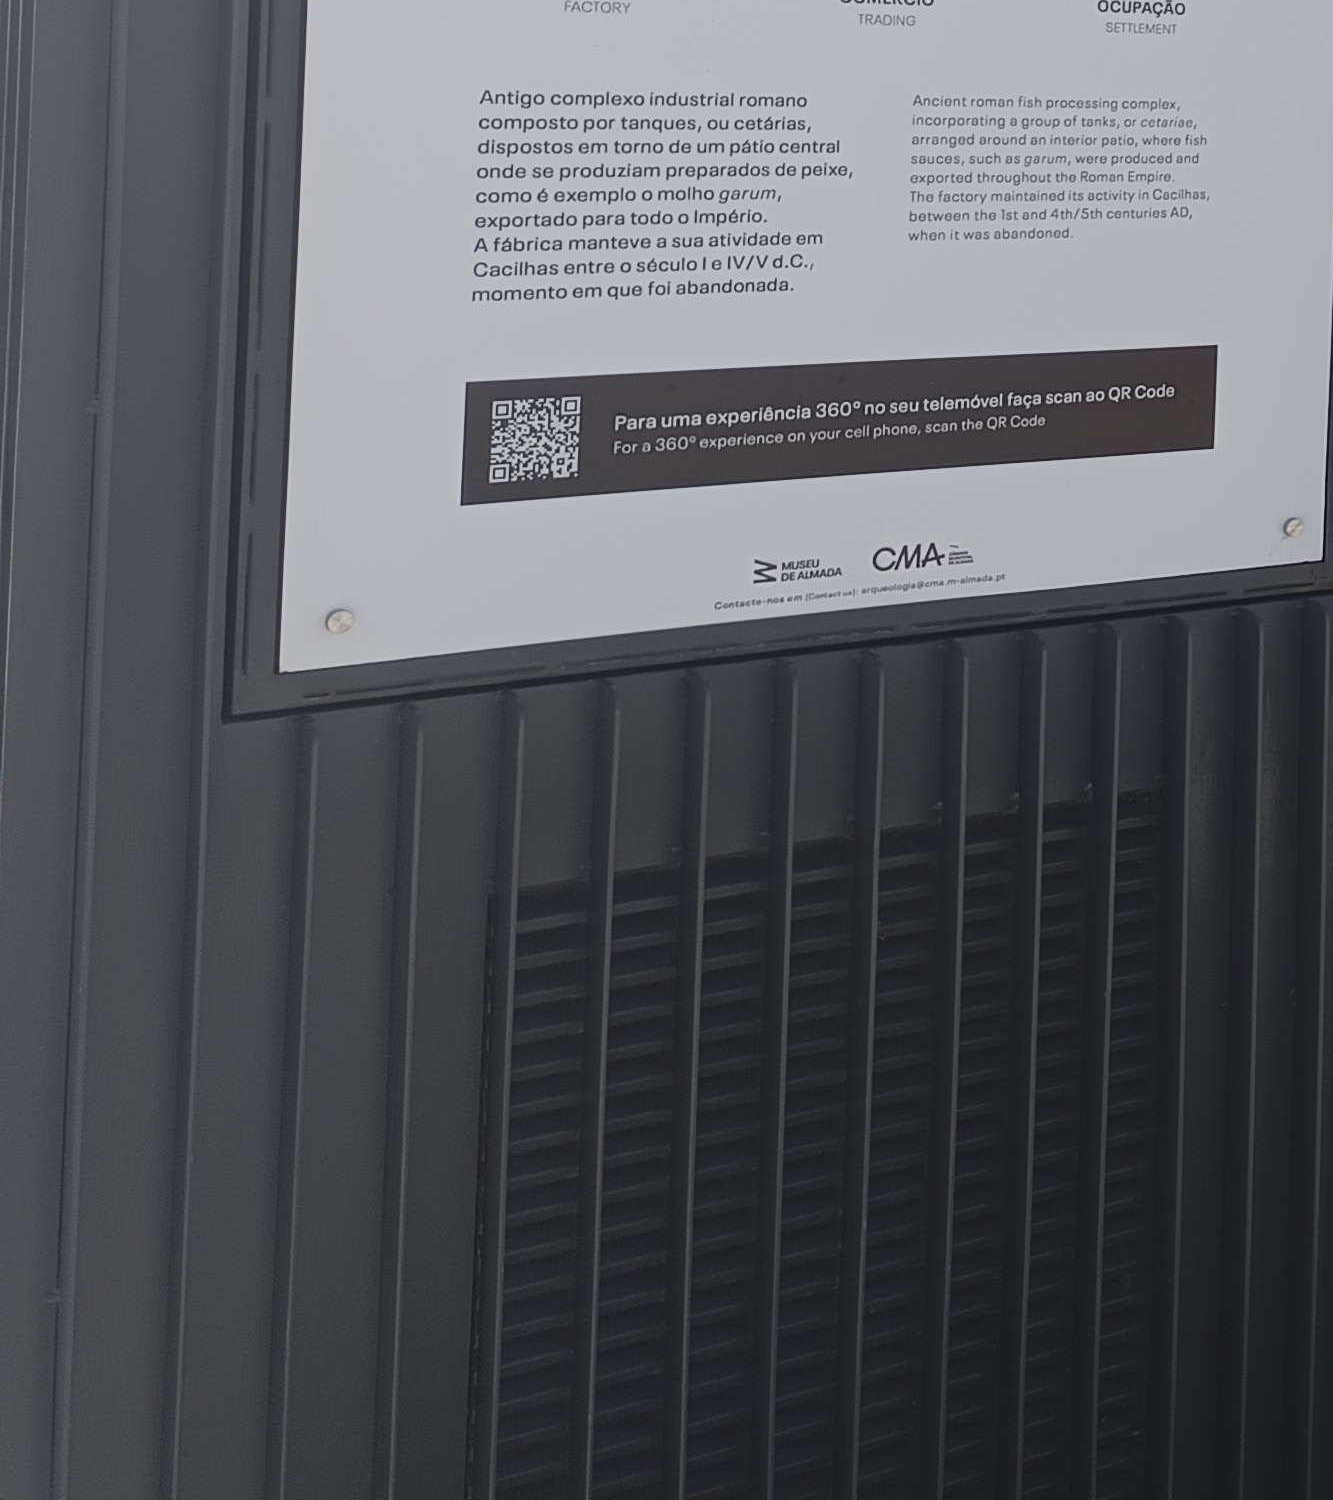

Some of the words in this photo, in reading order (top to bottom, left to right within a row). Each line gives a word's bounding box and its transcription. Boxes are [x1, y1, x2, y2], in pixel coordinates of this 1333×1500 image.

[564, 0, 631, 14] FACTORY
[1097, 0, 1186, 18] OCUPAÇÃO
[858, 13, 916, 26] TRADING
[1106, 22, 1177, 34] SETTLEMENT
[479, 90, 545, 109] Antigo
[550, 91, 645, 109] complexo
[650, 92, 734, 107] industrial
[739, 96, 807, 108] romano
[912, 94, 967, 107] Ancient
[970, 98, 1014, 108] roman
[1018, 95, 1042, 108] fish
[1046, 98, 1118, 112] processing
[1121, 98, 1180, 112] complex,
[478, 116, 578, 133] composto
[583, 118, 616, 133] por
[621, 117, 702, 133] tanques,
[707, 119, 729, 130] ou
[734, 116, 811, 133] cetárias,
[912, 114, 1006, 130] incorporating
[1009, 117, 1017, 127] a
[1021, 118, 1060, 130] group
[1063, 115, 1077, 127] of
[1081, 116, 1120, 129] tanks,
[1124, 118, 1137, 128] or
[1140, 116, 1197, 130] cetariae,
[477, 139, 573, 158] dispostos
[578, 142, 608, 154] em
[614, 141, 664, 154] torno
[669, 139, 692, 154] de
[697, 142, 725, 154] um
[729, 139, 775, 157] pátio
[779, 140, 840, 154] central
[615, 415, 657, 431] Para
[661, 414, 702, 428] uma
[706, 405, 811, 428] experiência
[864, 403, 886, 415] no
[889, 401, 919, 414] seu
[923, 393, 1003, 412] telemóvel
[1007, 392, 1042, 409] faça
[1045, 392, 1082, 405] scan
[1085, 390, 1105, 402] ao
[1108, 386, 1131, 403] QR
[1134, 384, 1175, 399] Code
[614, 441, 638, 454] For
[642, 442, 651, 452] a
[699, 433, 784, 450] experience
[787, 432, 806, 442] on
[809, 430, 841, 444] your
[845, 424, 870, 438] cell
[873, 424, 921, 440] phone,
[925, 422, 957, 433] scan
[961, 418, 983, 431] the
[987, 416, 1007, 430] QR
[1010, 414, 1046, 428] Code
[781, 559, 820, 571] MUSEU
[871, 542, 946, 572] CMA
[781, 572, 796, 582] DE
[797, 567, 843, 580] ALMADA
[714, 596, 785, 610] Contacte-nos
